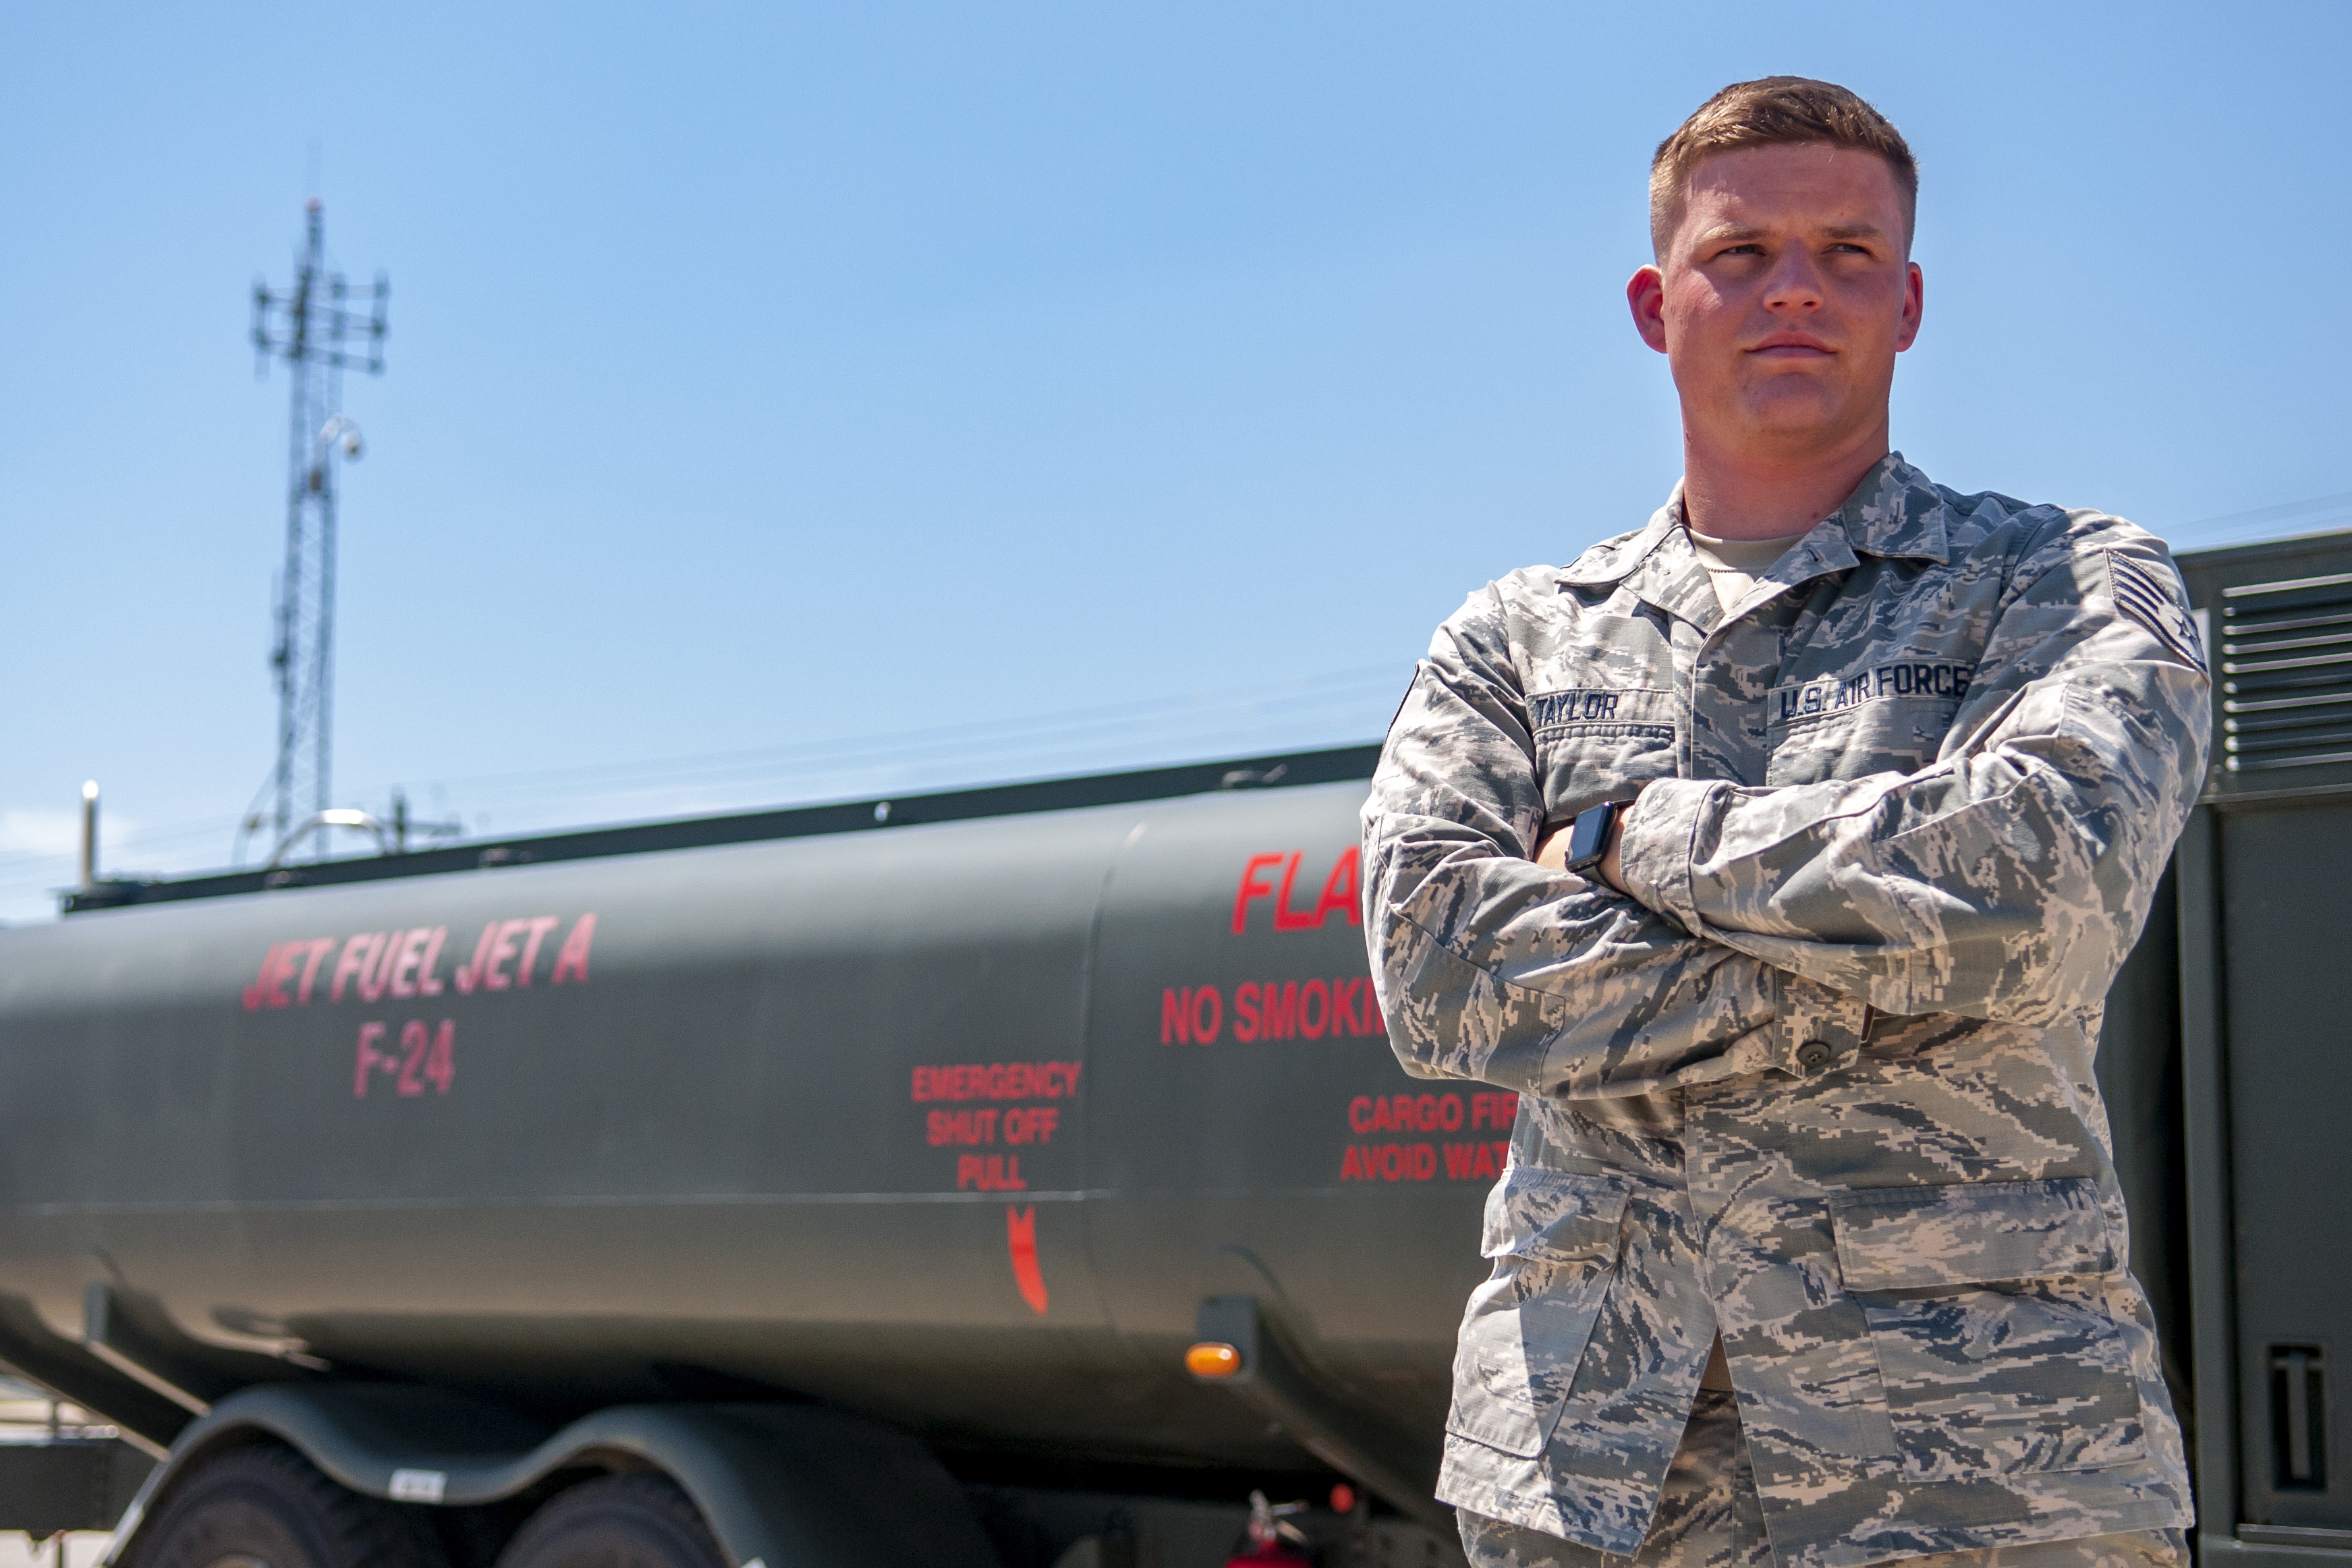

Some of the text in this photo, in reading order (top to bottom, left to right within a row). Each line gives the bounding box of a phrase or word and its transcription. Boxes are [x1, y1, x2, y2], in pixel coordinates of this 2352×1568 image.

[1535, 692, 1619, 727] TAYLOR
[1780, 663, 1969, 719] U.S. AIR FORCE
[244, 912, 598, 1009] JET FUEL JET A
[1160, 985, 1223, 1045] NO
[354, 1019, 454, 1097] F-24
[912, 1061, 1082, 1102] EMERGENCY
[926, 1107, 1060, 1146] SHUT OFF
[1349, 1093, 1465, 1133] CARGO
[957, 1154, 1028, 1192] PULL
[1340, 1143, 1437, 1182] AVOID
